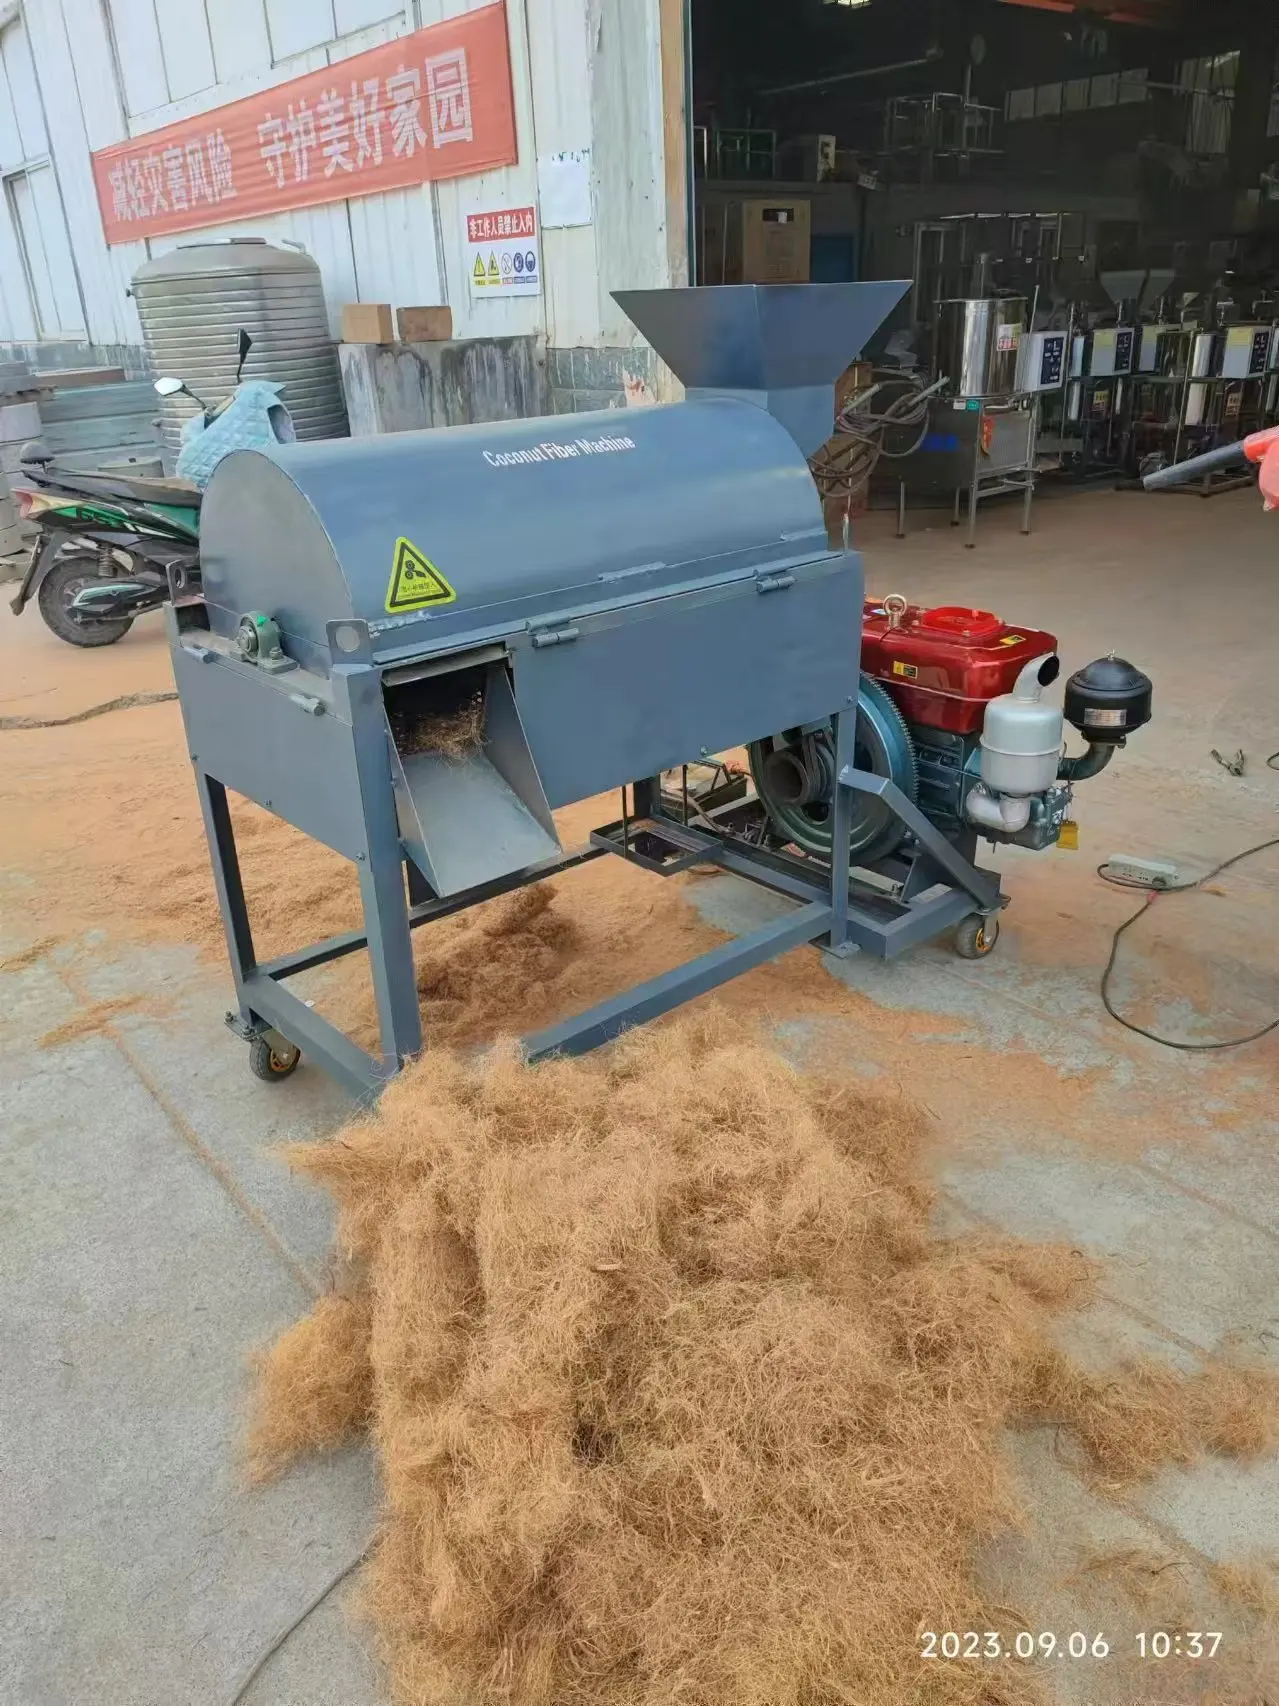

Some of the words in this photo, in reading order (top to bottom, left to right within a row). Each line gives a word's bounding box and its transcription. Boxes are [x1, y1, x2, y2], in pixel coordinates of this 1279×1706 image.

[108, 127, 238, 221] 减轻灾害风险
[257, 48, 473, 189] 守护美好家园
[470, 211, 533, 239] 非工作人员禁止入内
[482, 446, 548, 467] Coconut
[540, 442, 581, 460] Fiber
[574, 435, 636, 455] Machine
